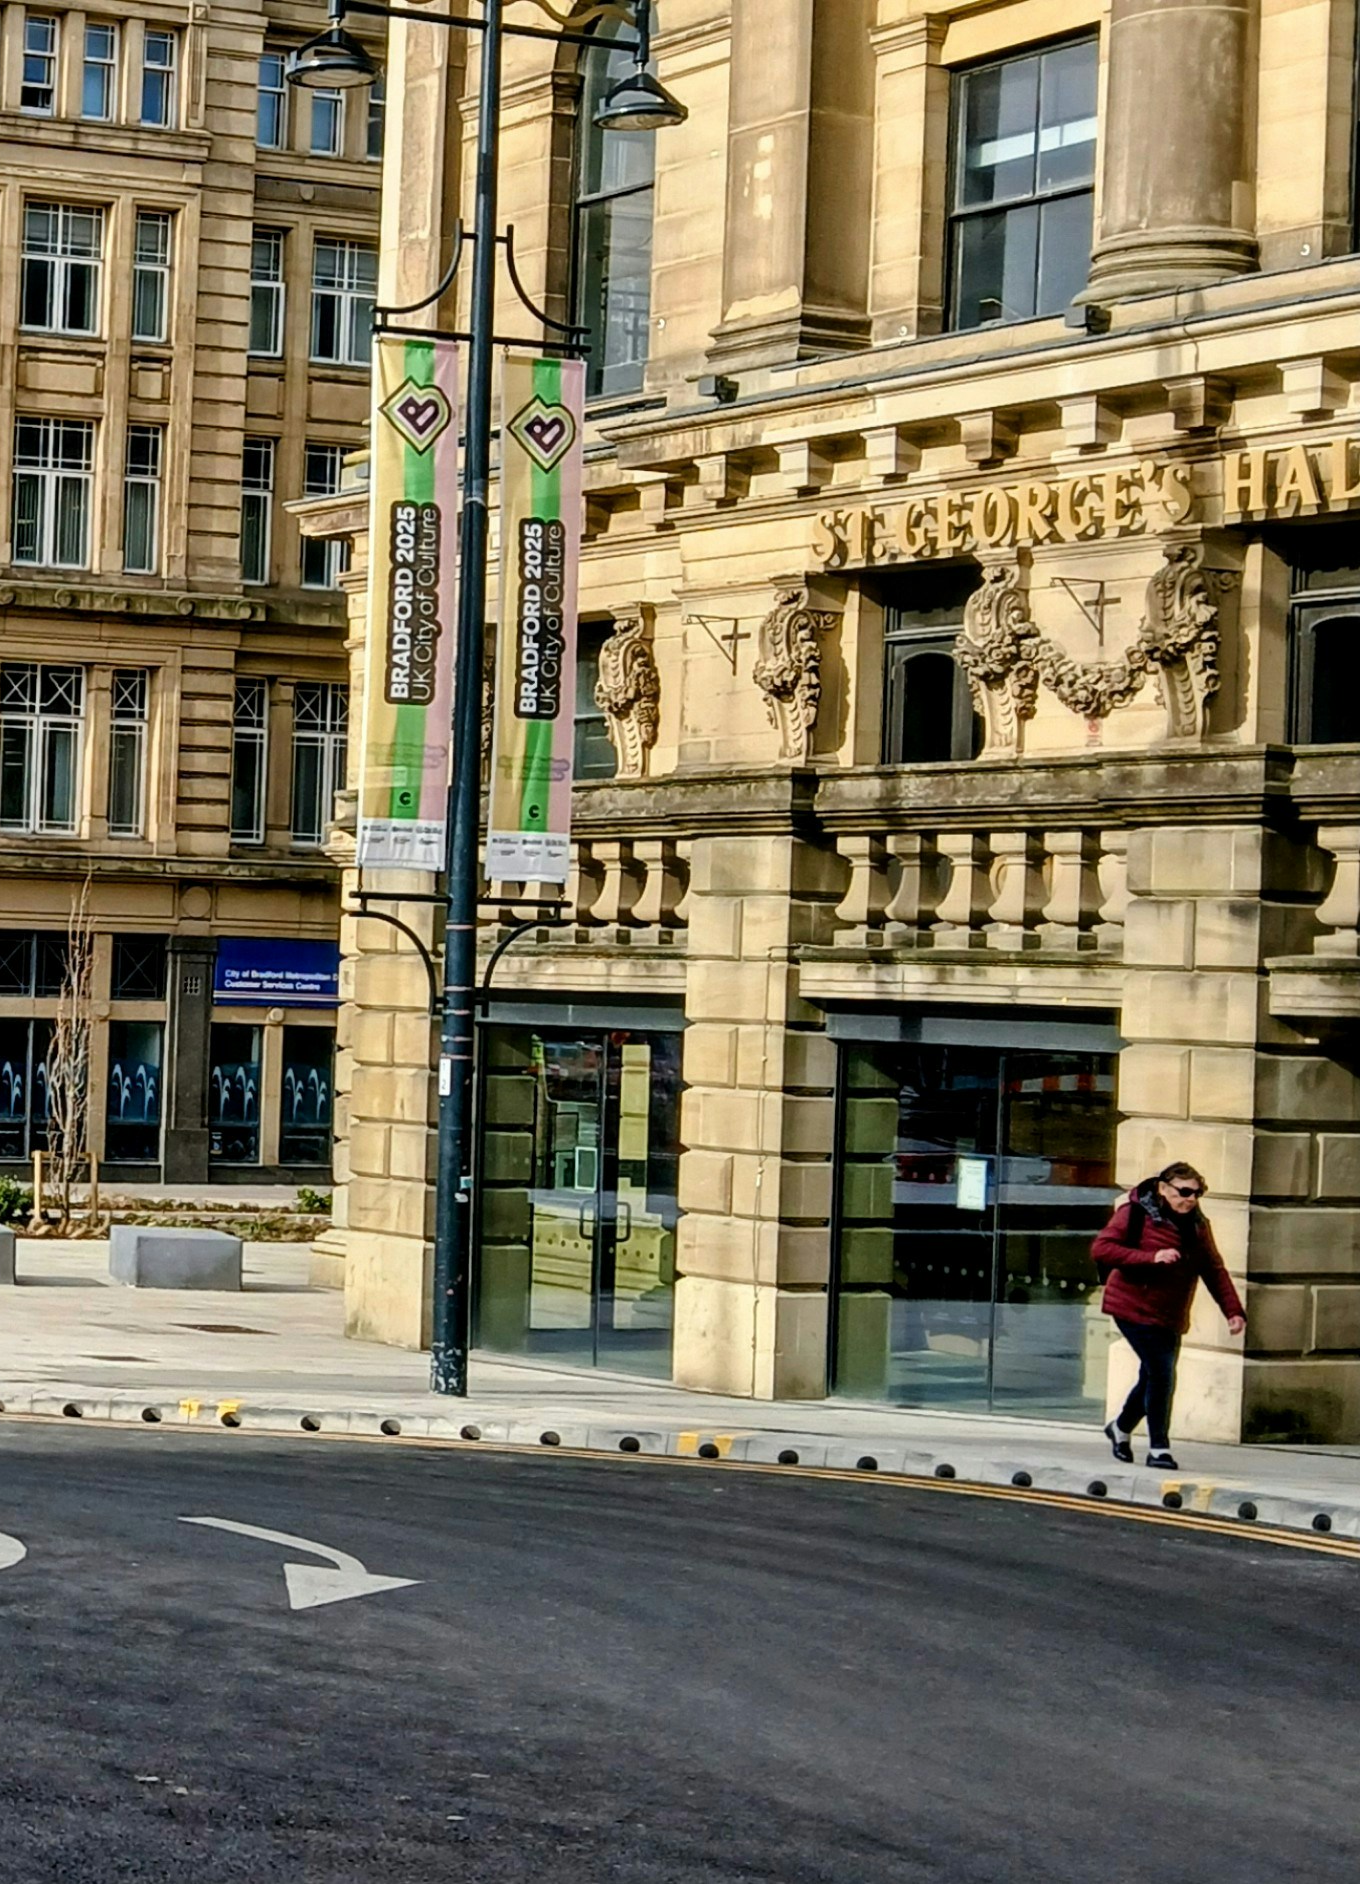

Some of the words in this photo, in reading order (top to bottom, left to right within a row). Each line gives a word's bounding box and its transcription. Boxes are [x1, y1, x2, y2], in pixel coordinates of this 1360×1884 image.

[395, 506, 416, 563] 2025
[809, 505, 886, 565] ST.
[896, 459, 1192, 561] GEORGE'S
[416, 508, 437, 586] Culture
[524, 524, 543, 579] 2025
[543, 525, 562, 603] Culture
[416, 591, 434, 615] of
[543, 608, 559, 631] of
[390, 567, 414, 699] BRADFORD
[413, 620, 438, 662] City
[519, 584, 541, 713] BRADFORD
[541, 635, 563, 678] City
[411, 668, 432, 700] UK
[539, 684, 557, 714] UK
[251, 970, 283, 979] Bradford
